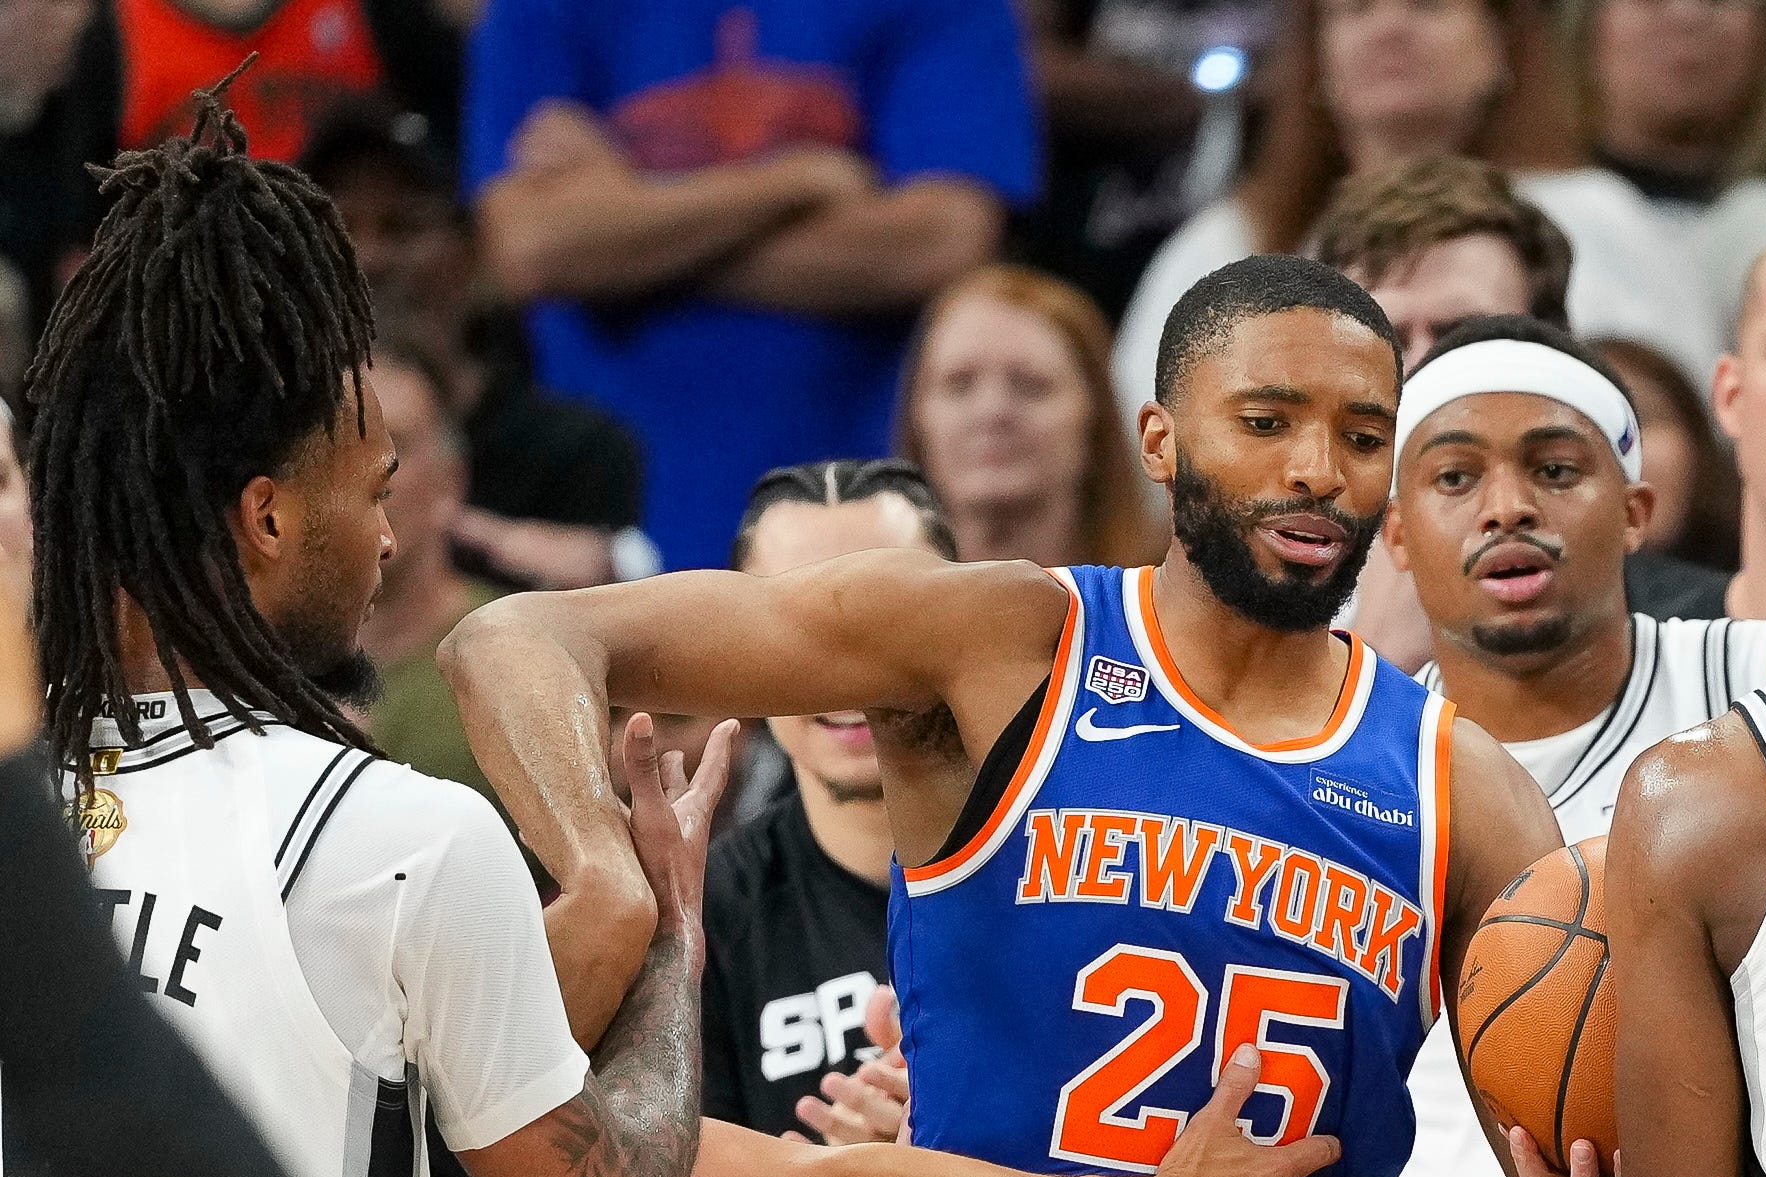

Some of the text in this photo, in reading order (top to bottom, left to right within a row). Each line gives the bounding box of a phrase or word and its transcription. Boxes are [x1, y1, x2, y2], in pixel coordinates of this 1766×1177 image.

[1097, 661, 1142, 682] USA
[1091, 676, 1142, 699] 250
[1312, 787, 1352, 811] abu
[1315, 775, 1369, 799] experience
[1015, 807, 1425, 1004] NEW YORK
[1049, 943, 1351, 1175] 25
